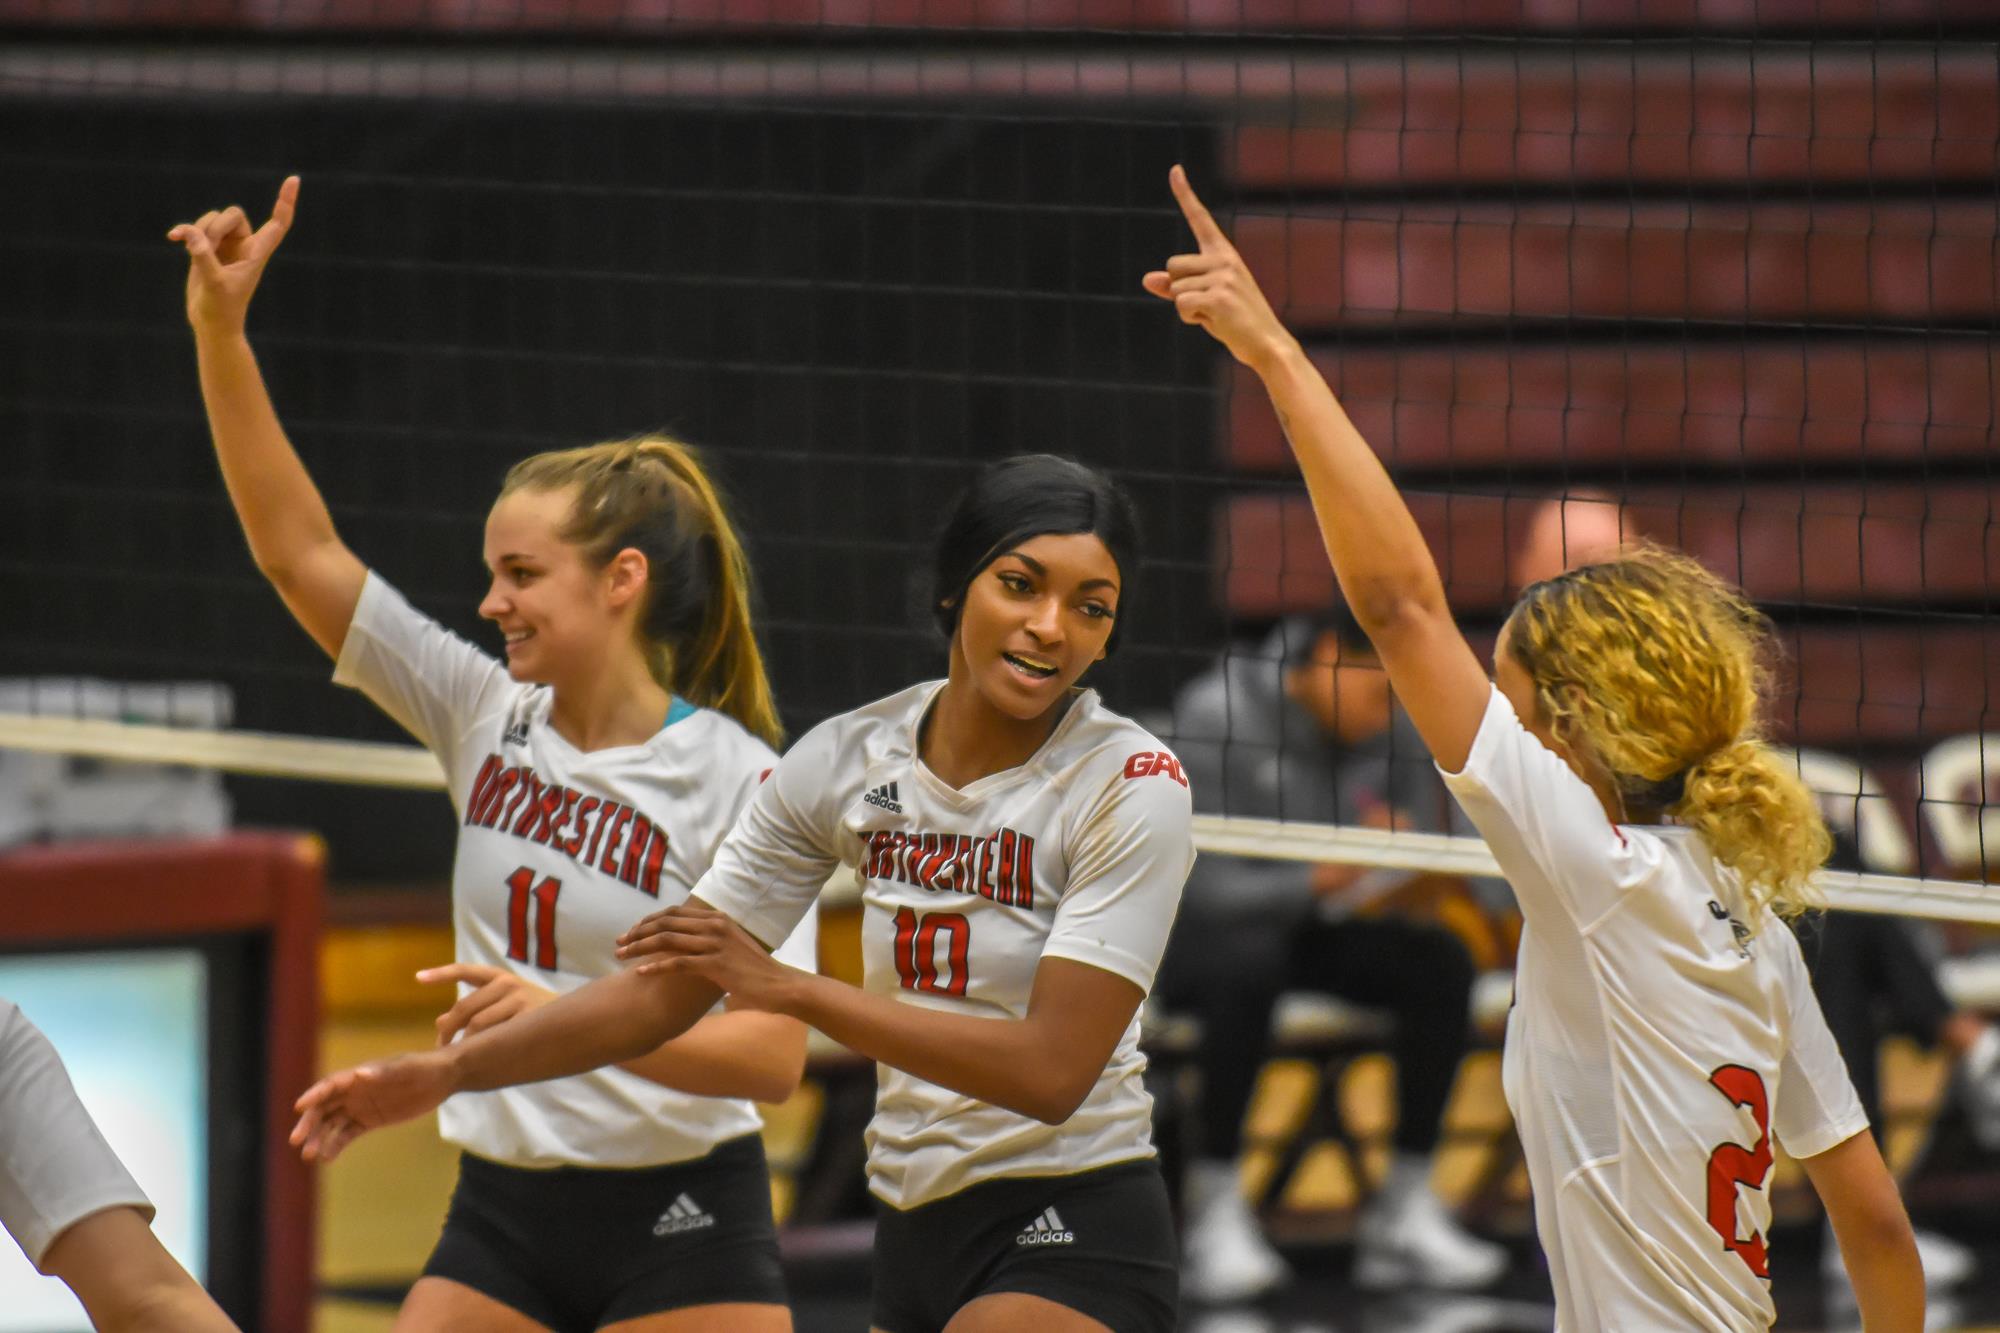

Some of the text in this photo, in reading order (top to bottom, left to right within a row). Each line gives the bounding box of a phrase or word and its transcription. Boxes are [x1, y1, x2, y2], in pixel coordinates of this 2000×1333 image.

[863, 793, 903, 814] adidas
[505, 866, 562, 971] 11
[893, 905, 971, 997] 10
[1707, 1064, 1774, 1279] 2
[652, 1213, 714, 1236] adidas
[1016, 1230, 1073, 1246] adidas
